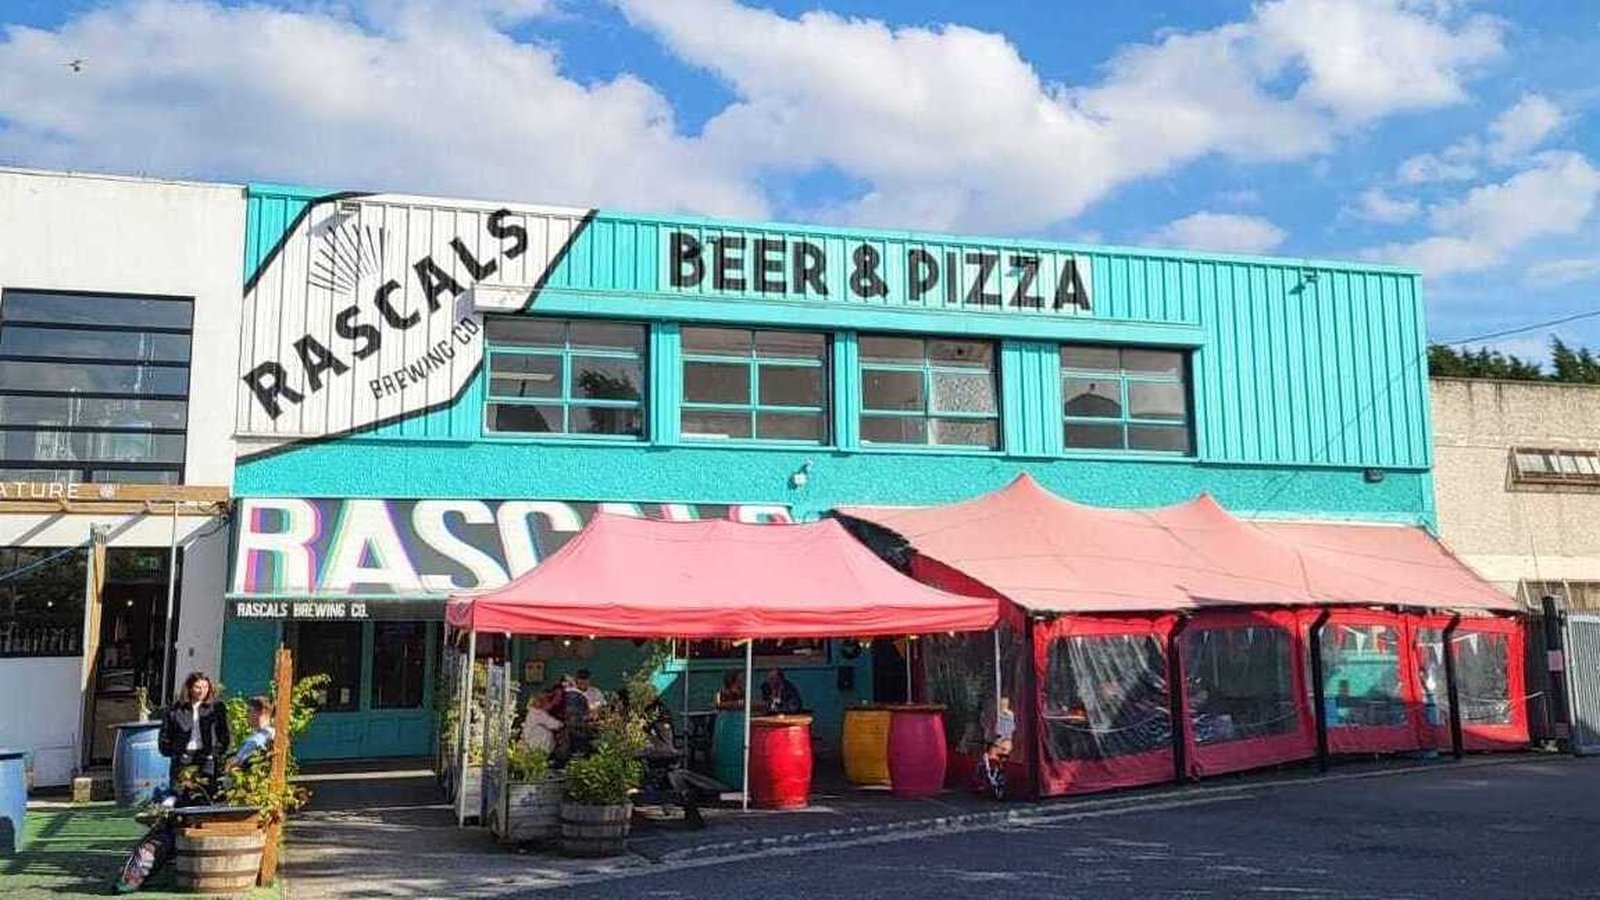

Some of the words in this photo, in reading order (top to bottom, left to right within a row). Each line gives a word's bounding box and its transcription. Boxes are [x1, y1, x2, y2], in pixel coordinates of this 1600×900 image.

[668, 230, 829, 297] BEER
[848, 243, 889, 299] &
[907, 247, 1091, 311] PIZZA
[242, 208, 529, 420] RASCALS
[368, 339, 456, 400] BREWING
[236, 602, 289, 618] RASCALS
[292, 602, 346, 618] BREWING
[350, 602, 369, 618] CO.
